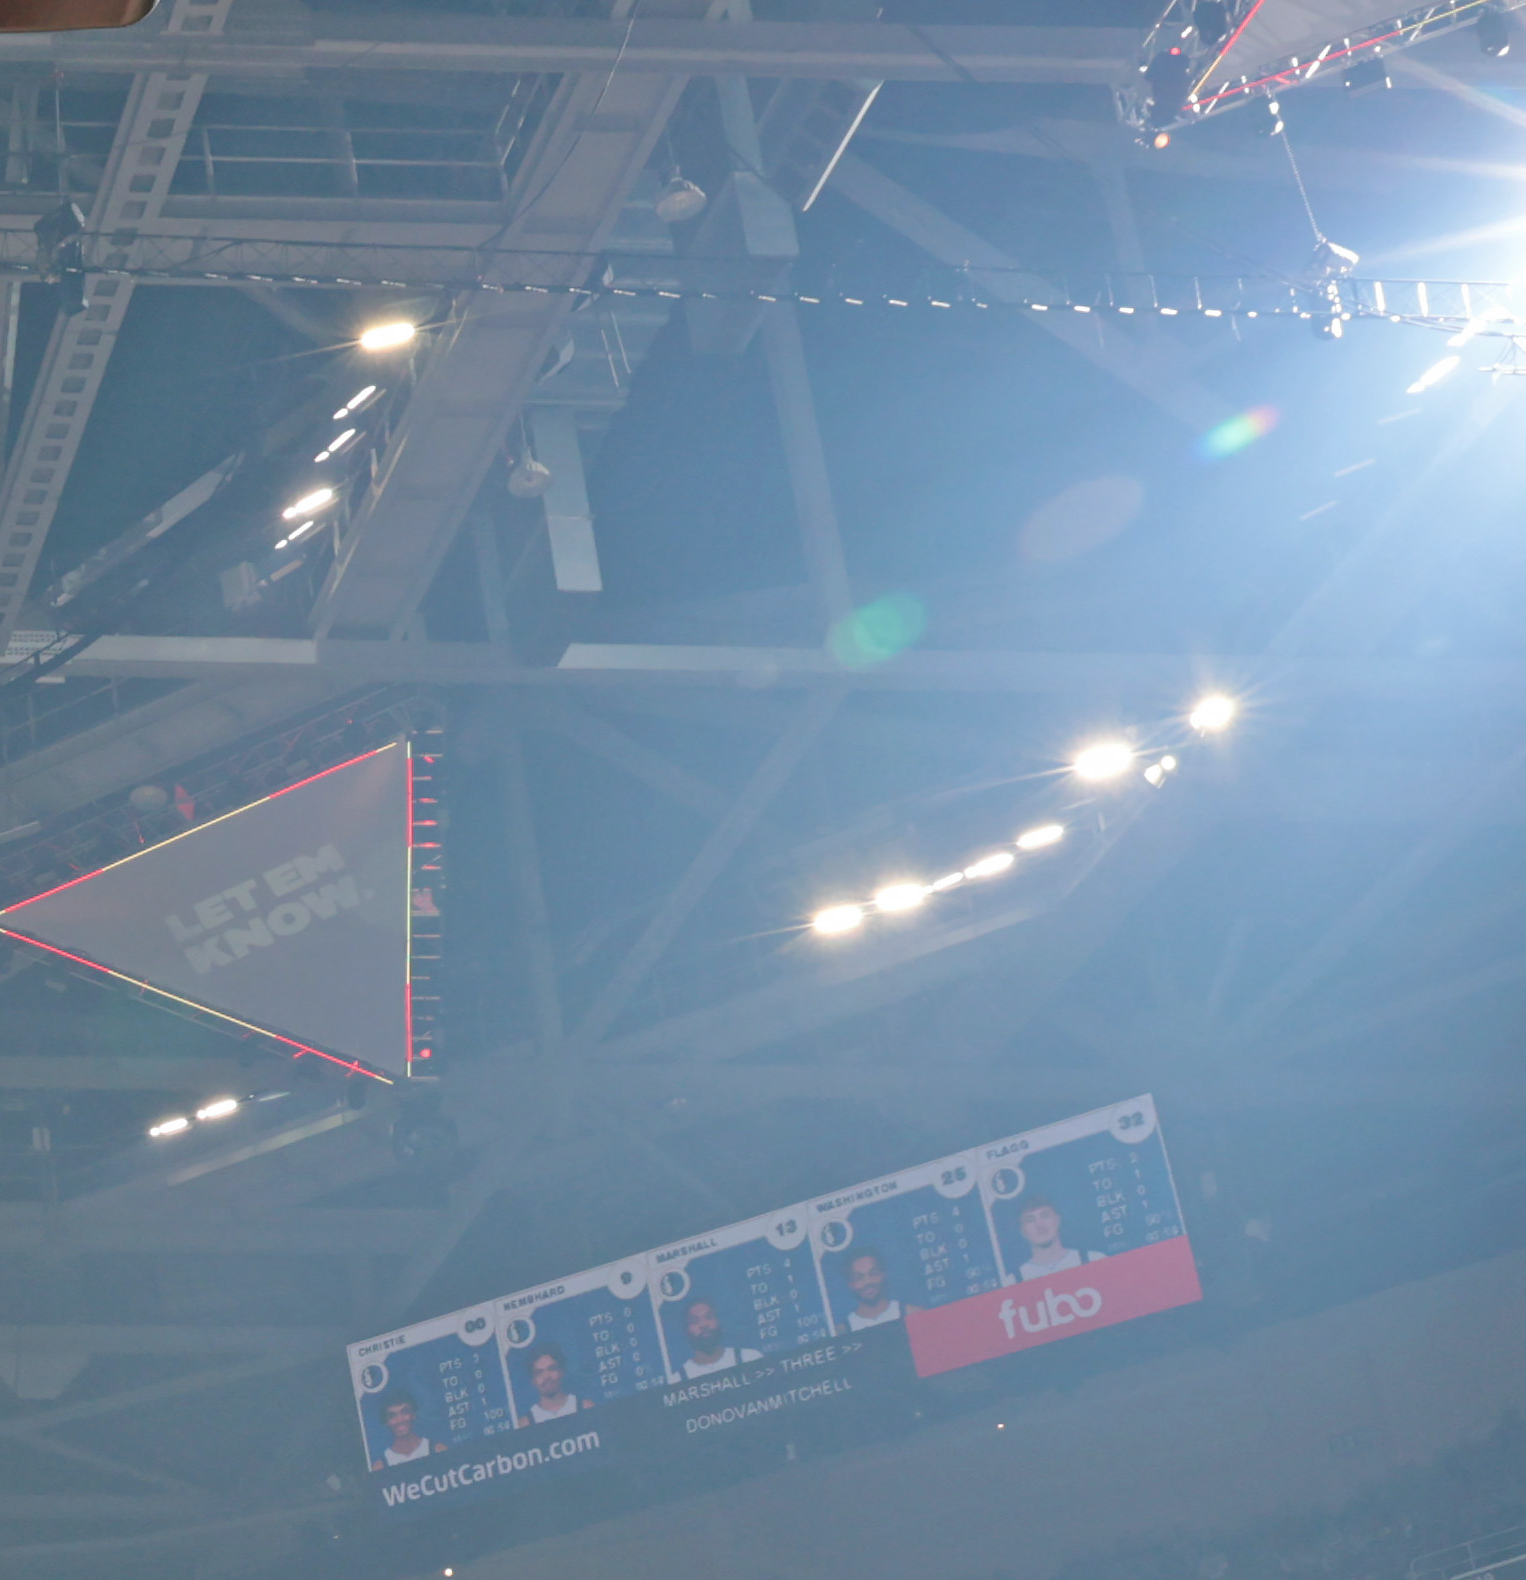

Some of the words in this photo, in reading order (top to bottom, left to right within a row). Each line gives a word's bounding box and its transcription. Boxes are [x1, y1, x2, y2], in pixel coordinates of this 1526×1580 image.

[164, 879, 257, 942] LET
[262, 844, 346, 898] EM
[1118, 1112, 1145, 1130] 32
[987, 1140, 1029, 1160] FLAGG
[941, 1167, 966, 1186] 25
[1088, 1158, 1117, 1175] PTS
[817, 1180, 898, 1212] WASHINGTON
[1093, 1178, 1113, 1191] TO
[1101, 1206, 1128, 1223] AST
[776, 1220, 796, 1237] 13
[657, 1239, 717, 1263] MARSHALL
[998, 1287, 1102, 1339] fubo
[359, 1334, 406, 1357] CHRISTIE
[663, 1373, 751, 1408] MARSHALL
[780, 1346, 837, 1374] THREE
[686, 1378, 852, 1434] DONOVANMITCHELL
[381, 1428, 601, 1507] WeCutCarbon.com
